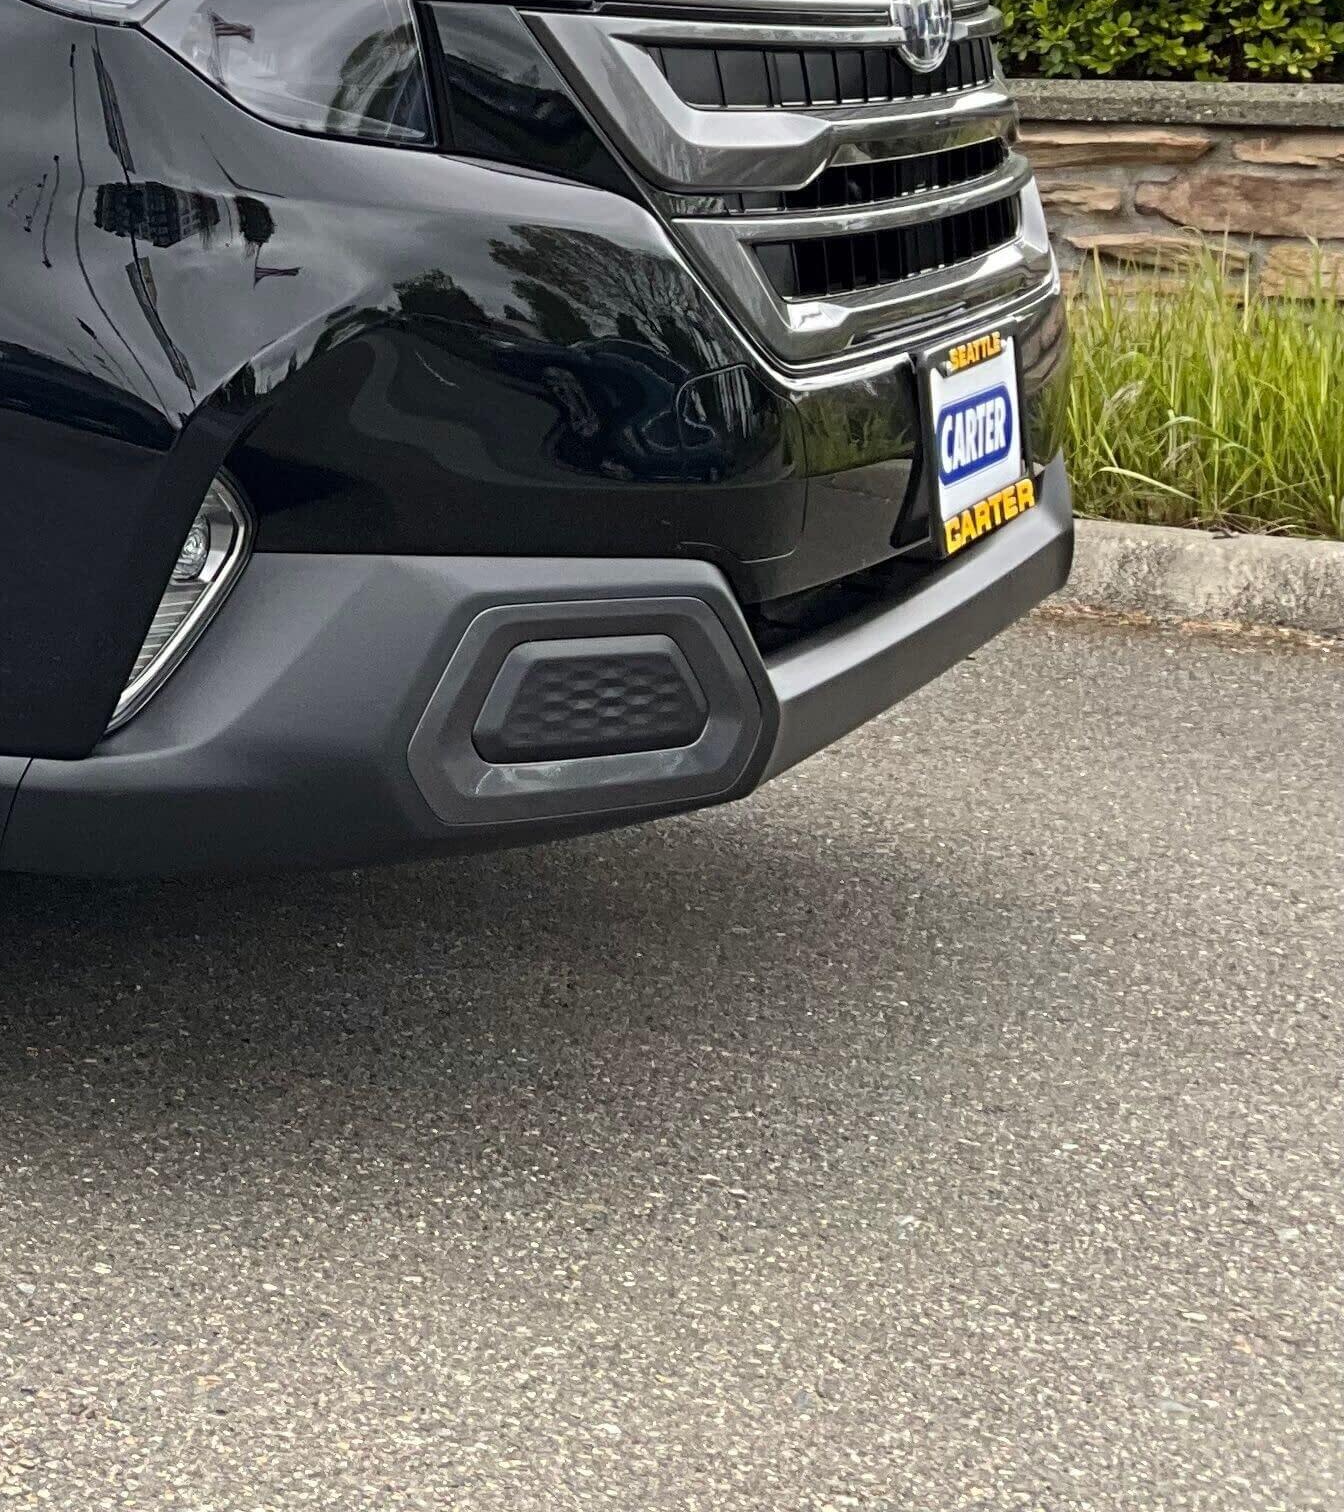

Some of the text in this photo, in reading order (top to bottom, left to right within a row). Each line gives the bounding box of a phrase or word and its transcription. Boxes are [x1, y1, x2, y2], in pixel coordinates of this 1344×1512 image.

[949, 332, 1001, 370] SEATTLE
[941, 396, 1006, 473] CARTER
[945, 479, 1035, 554] CARTER
